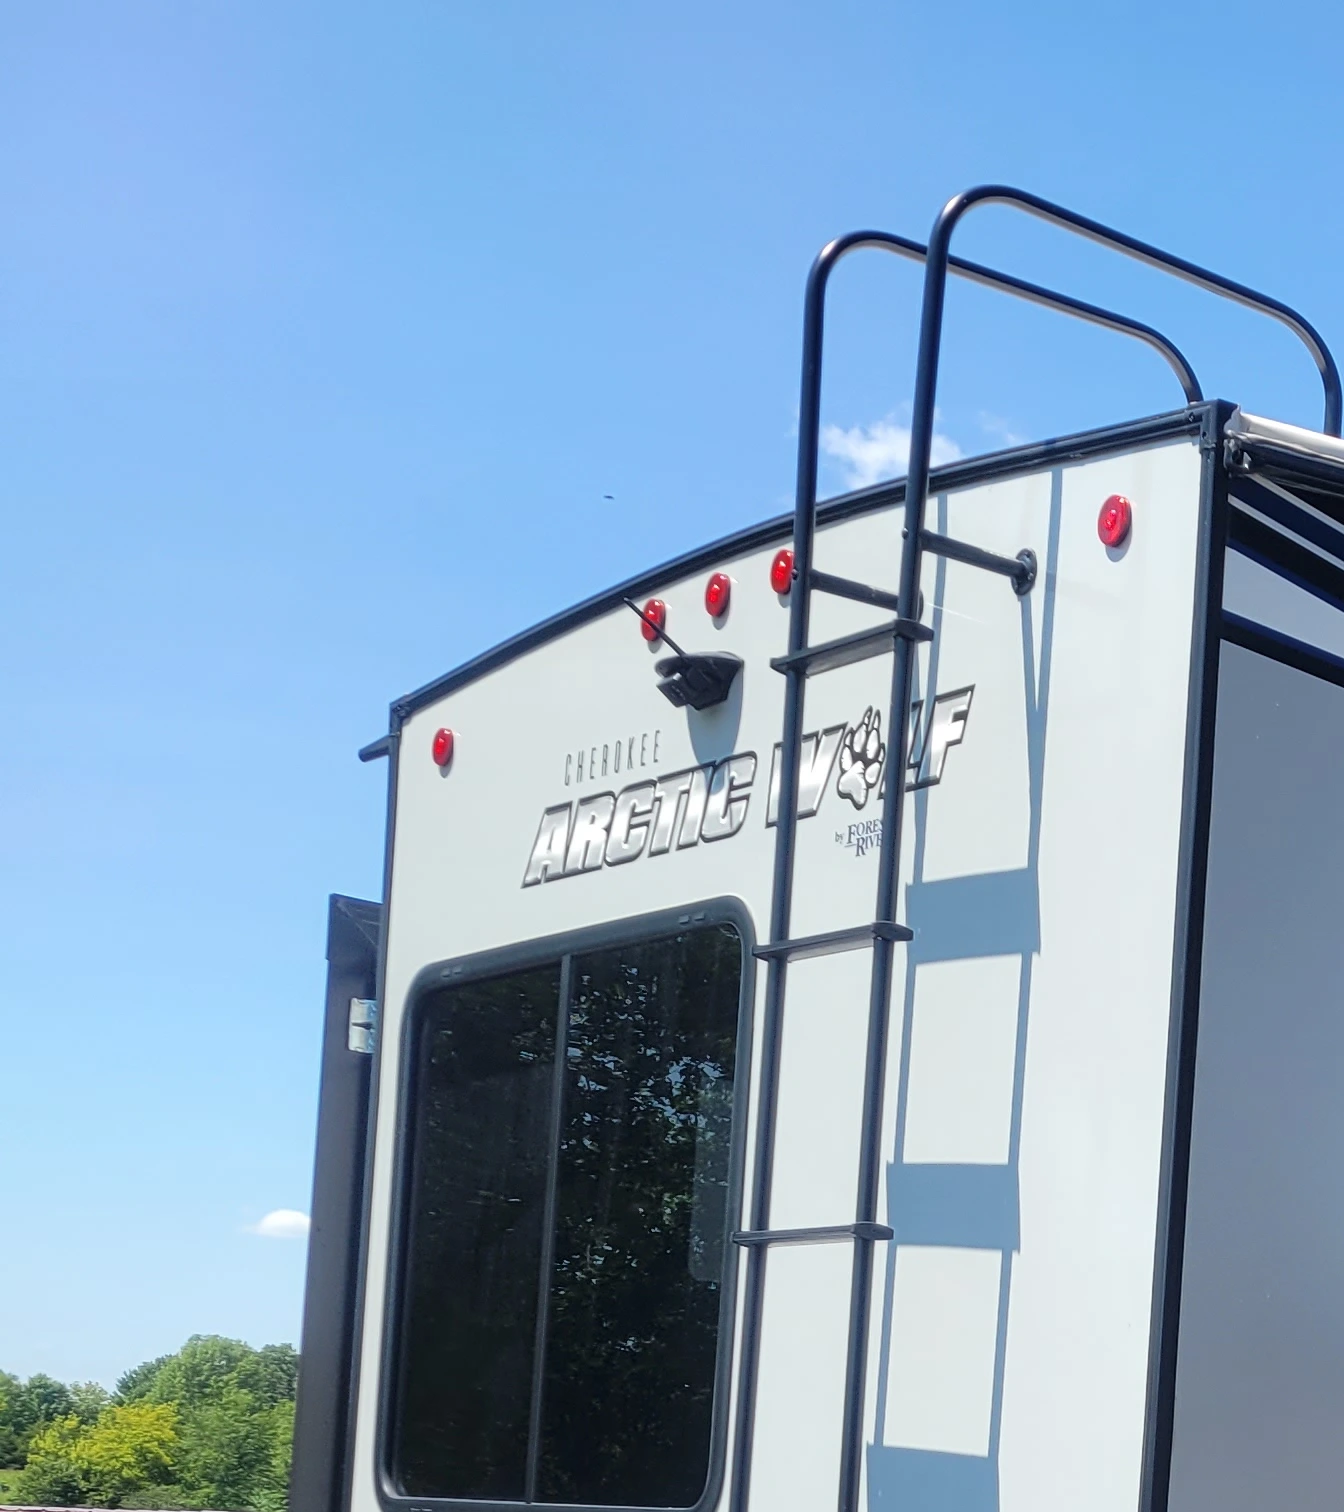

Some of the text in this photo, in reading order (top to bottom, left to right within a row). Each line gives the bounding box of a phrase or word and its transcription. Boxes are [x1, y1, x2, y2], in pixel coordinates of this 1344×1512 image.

[563, 728, 663, 787] CHEROKEE
[521, 750, 758, 889] ARCTIC
[846, 818, 884, 845] FORE
[834, 831, 844, 845] by
[855, 833, 883, 857] RIVE
